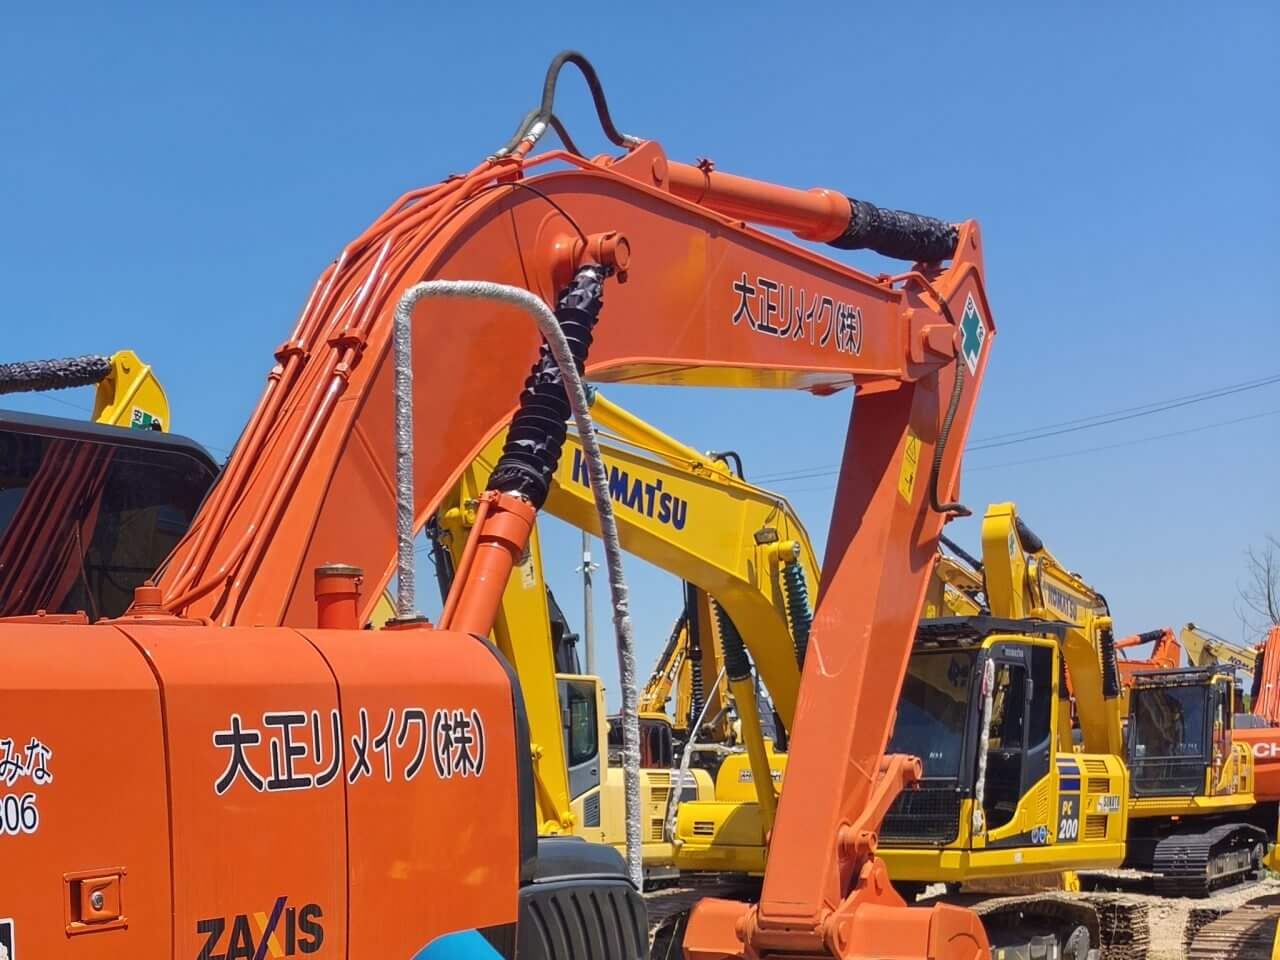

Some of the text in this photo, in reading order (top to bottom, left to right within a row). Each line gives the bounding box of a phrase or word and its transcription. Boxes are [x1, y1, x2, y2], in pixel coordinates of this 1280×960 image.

[732, 272, 864, 356] 大正リメイク(株)
[571, 447, 688, 530] KMATSU
[213, 707, 485, 795] 大正リメイク(株)
[1058, 818, 1079, 840] 200
[1061, 800, 1073, 816] PC
